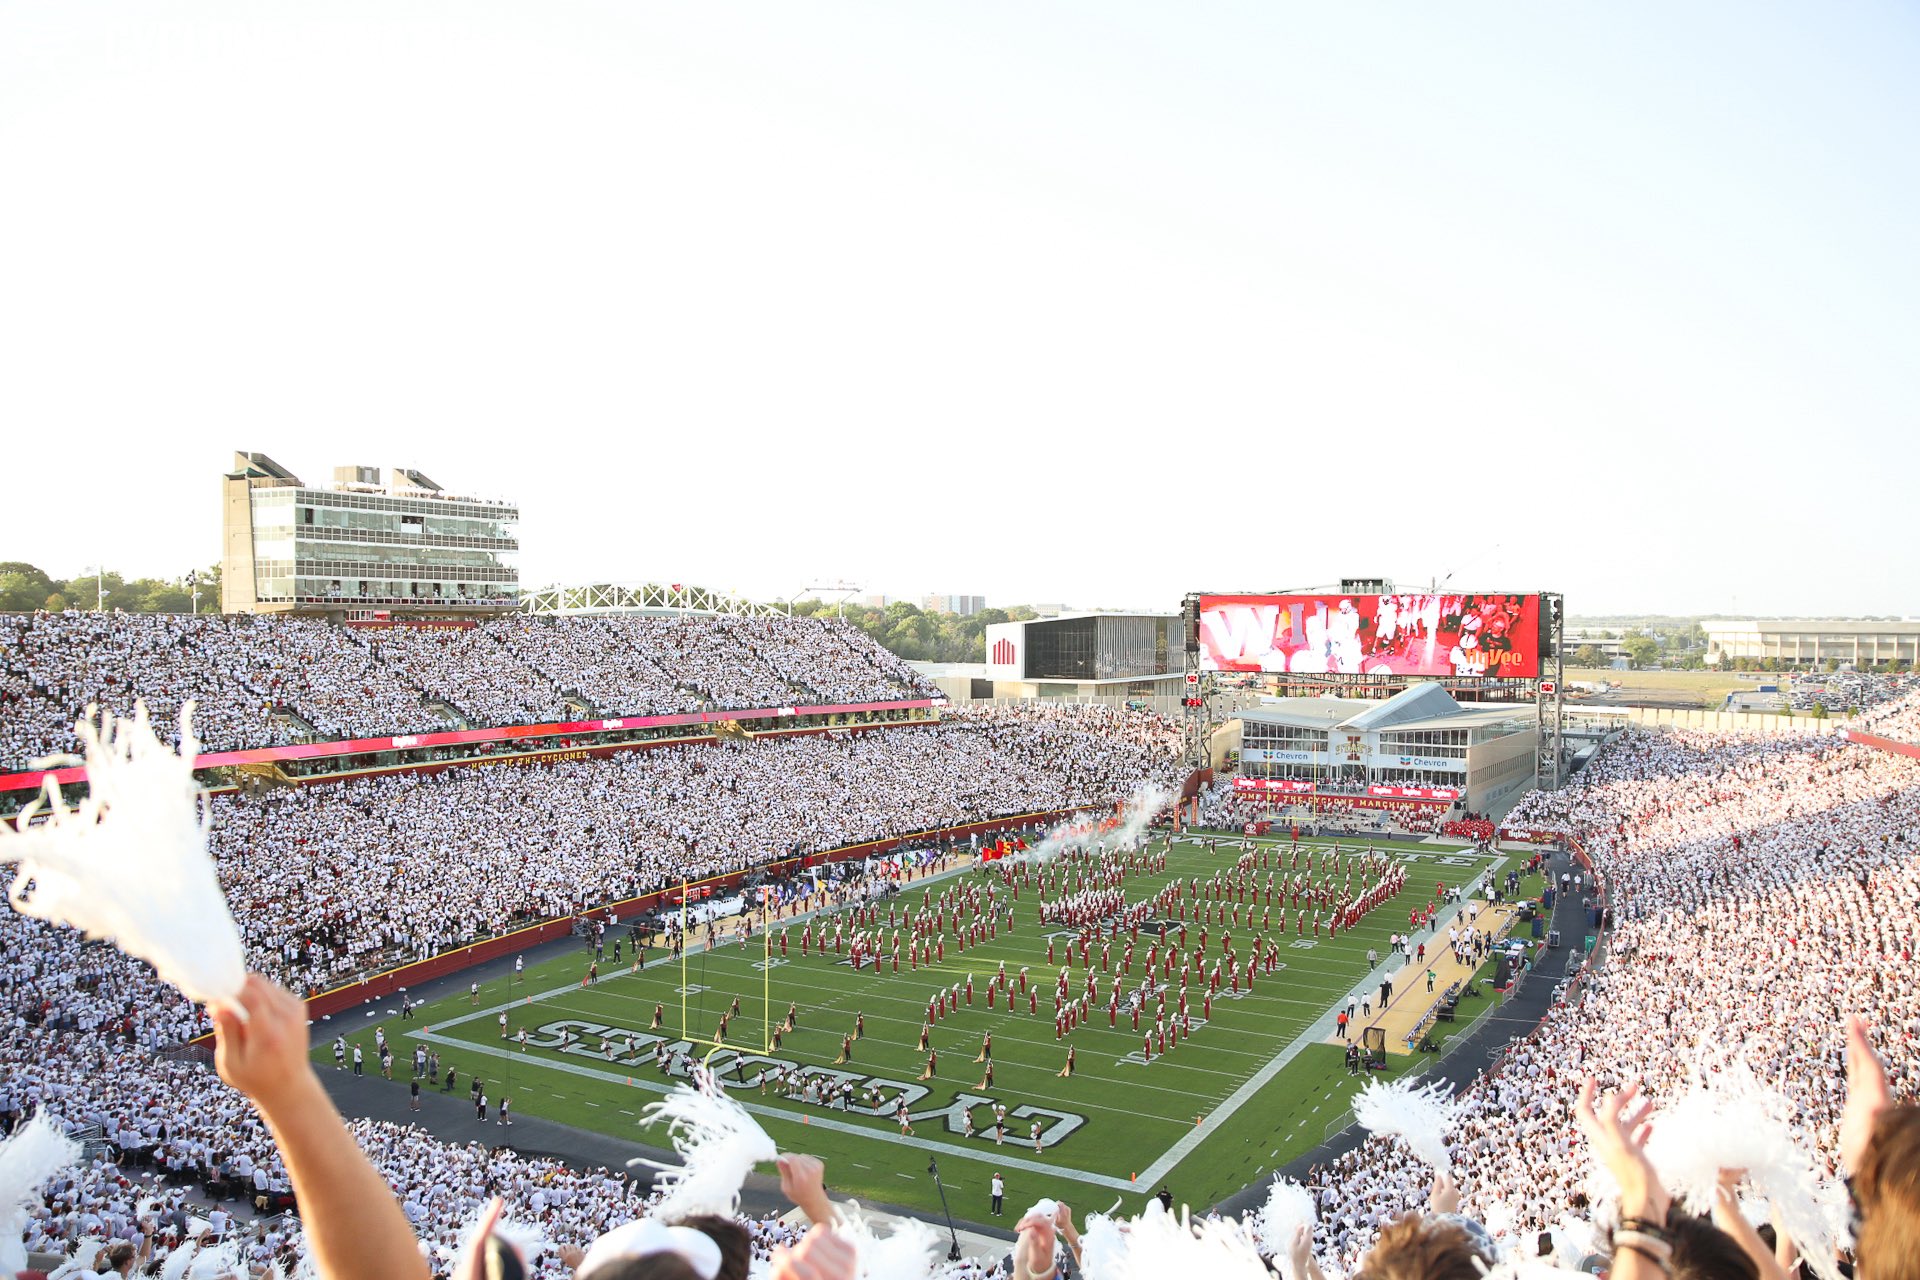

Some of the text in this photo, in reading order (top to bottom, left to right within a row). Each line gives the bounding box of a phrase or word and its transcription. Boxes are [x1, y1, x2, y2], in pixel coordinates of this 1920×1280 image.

[541, 751, 588, 763] CYCLONES
[1276, 751, 1308, 760] Chevron
[1414, 757, 1447, 767] Chevron
[1359, 800, 1415, 809] MARCHING
